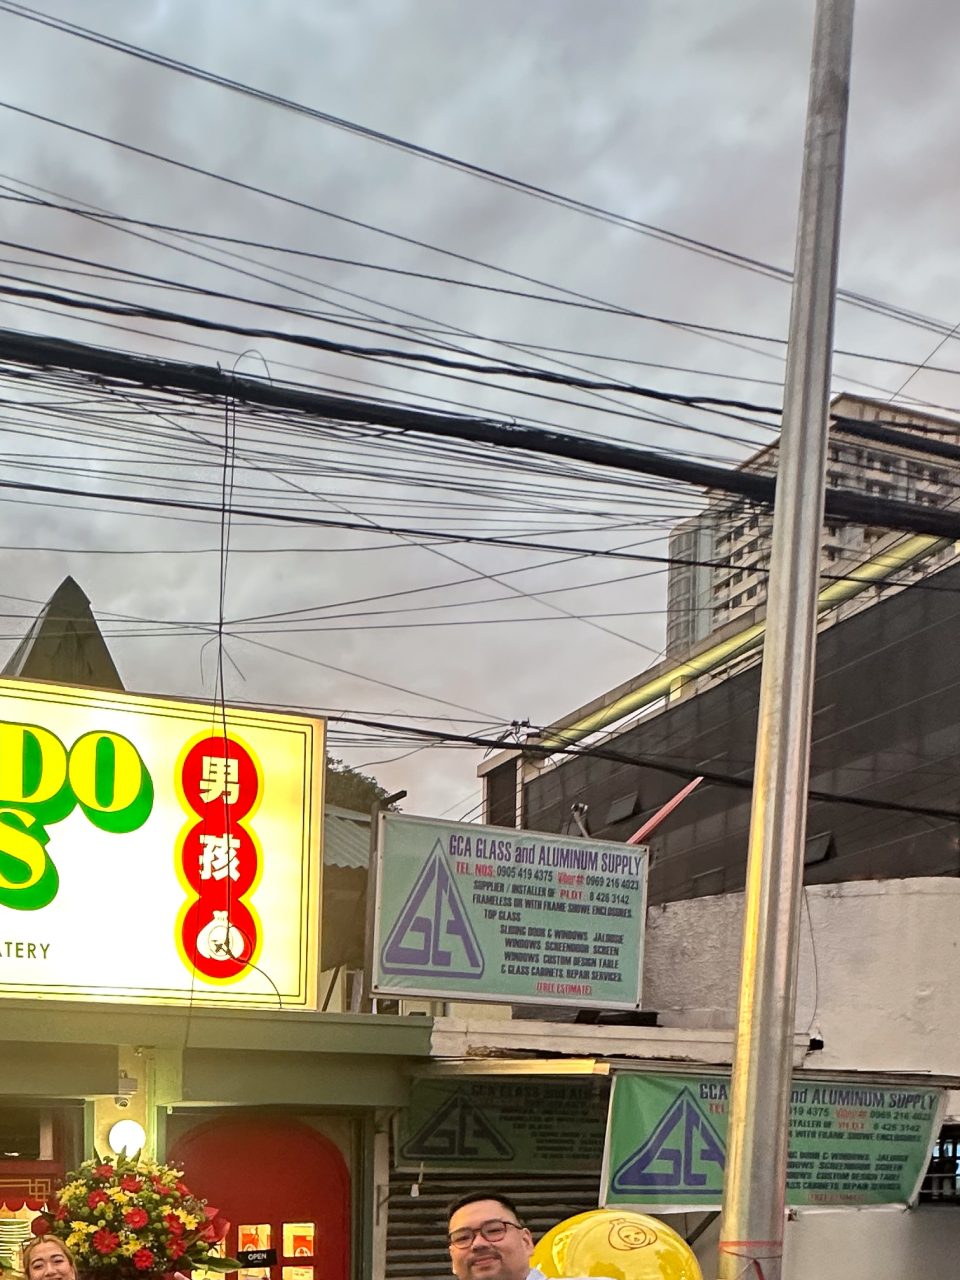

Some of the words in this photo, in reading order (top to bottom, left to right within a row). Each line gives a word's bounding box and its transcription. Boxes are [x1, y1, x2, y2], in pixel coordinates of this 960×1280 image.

[197, 755, 241, 883] 男孩
[449, 834, 472, 858] GCA
[475, 838, 512, 862] GLASS
[514, 844, 536, 864] and
[538, 846, 599, 871] ALUMINUM
[601, 852, 642, 876] SUPPLY
[496, 865, 516, 879] 0905
[517, 867, 533, 881] 419
[534, 869, 553, 882] 4375
[699, 1083, 728, 1100] GCA
[790, 1087, 808, 1105] nd
[811, 1088, 885, 1109] ALUMINUM
[888, 1092, 937, 1111] SUPPLY
[790, 1106, 805, 1117] 19
